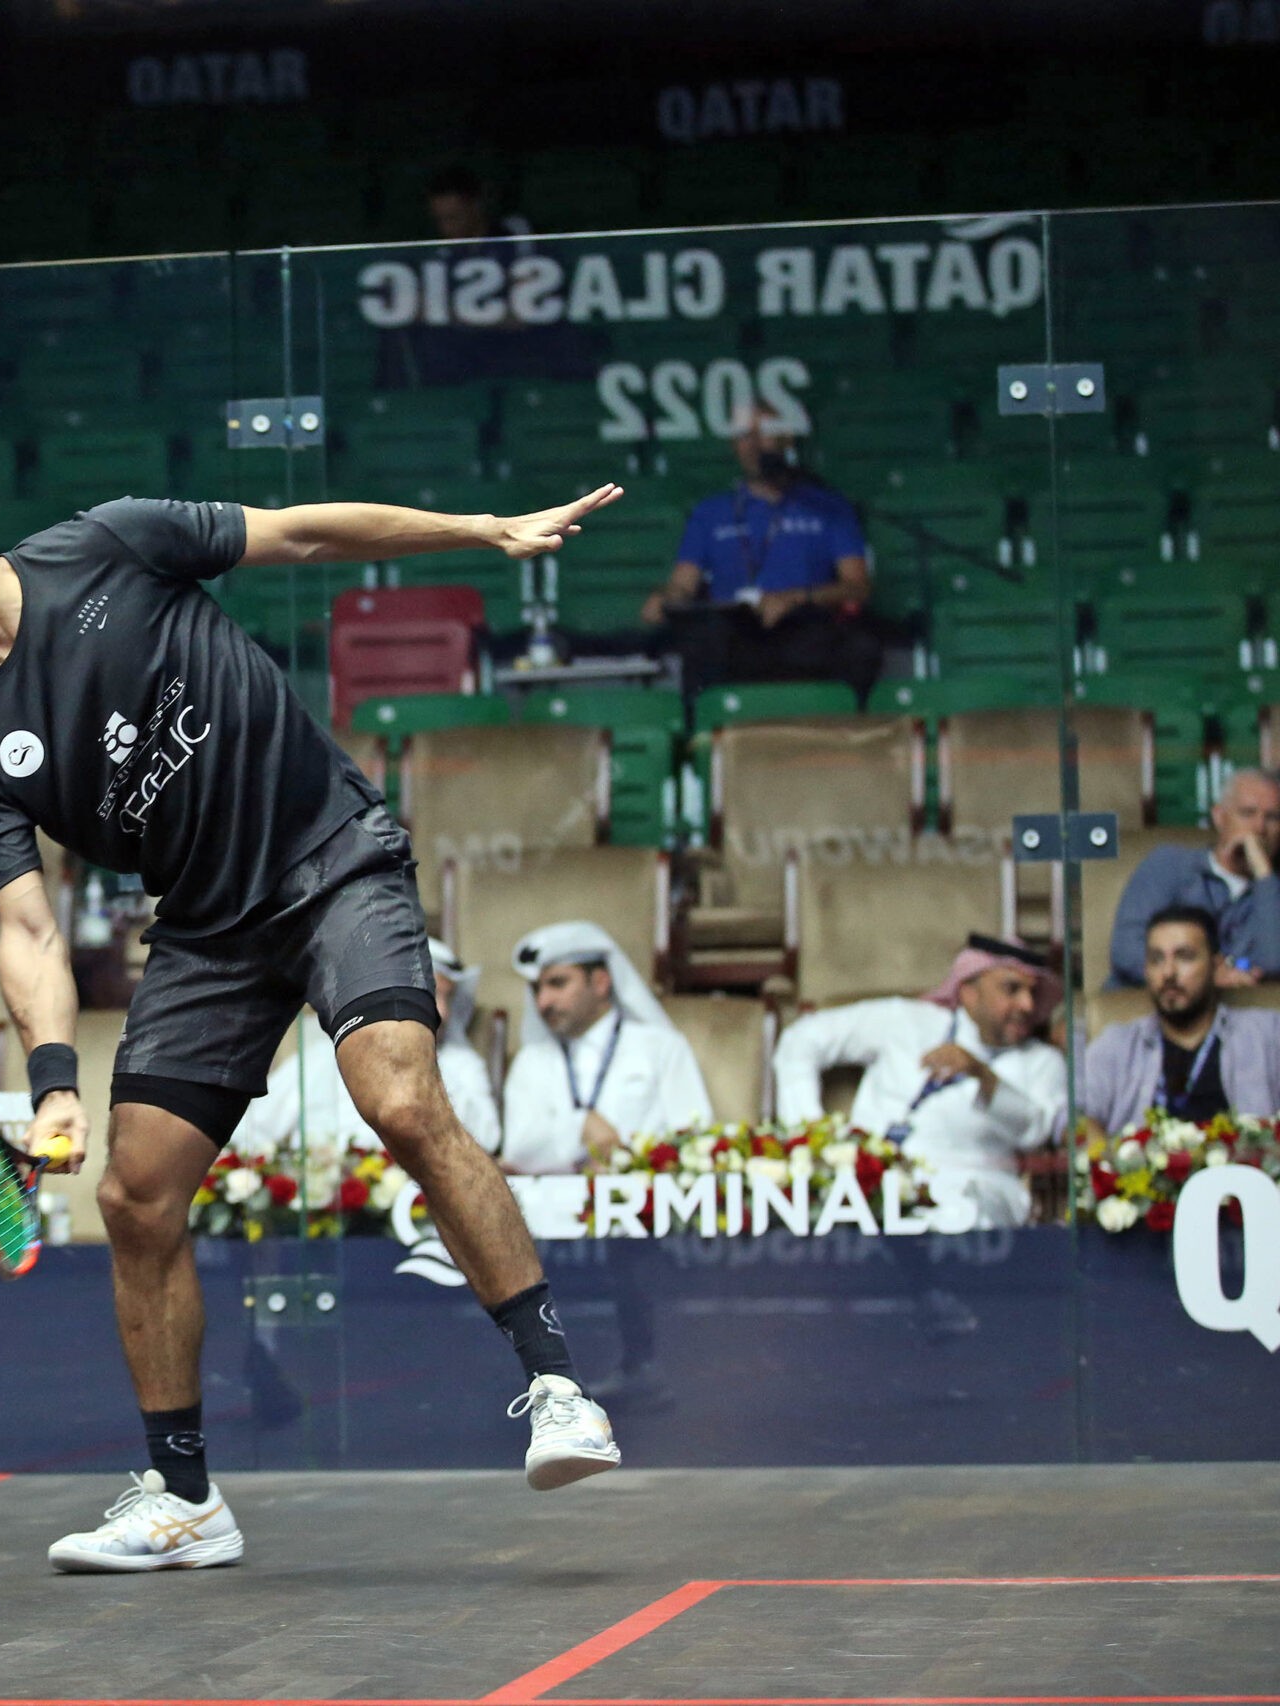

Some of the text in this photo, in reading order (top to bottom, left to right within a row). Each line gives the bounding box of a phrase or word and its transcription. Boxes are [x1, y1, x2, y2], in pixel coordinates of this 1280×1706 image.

[127, 50, 310, 107] QATAR
[657, 78, 845, 144] QATAR
[1173, 1164, 1280, 1354] Q
